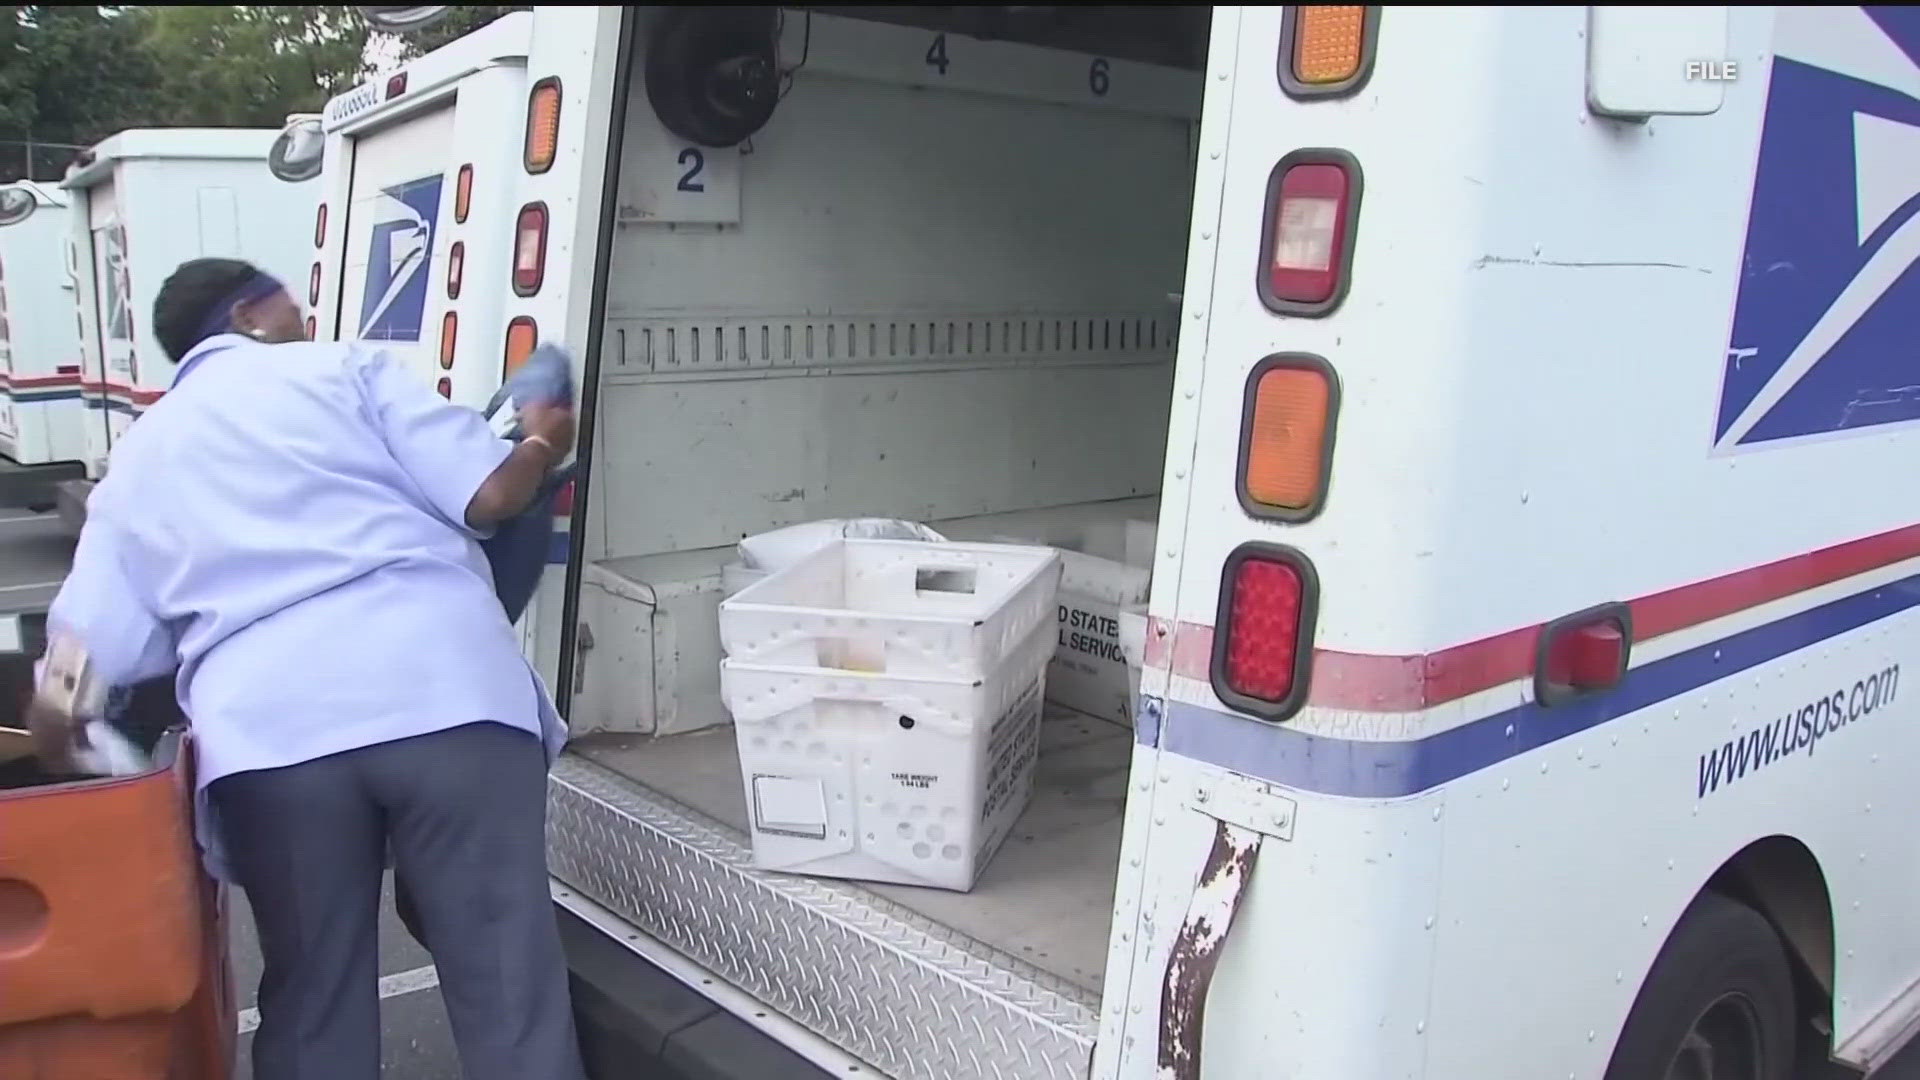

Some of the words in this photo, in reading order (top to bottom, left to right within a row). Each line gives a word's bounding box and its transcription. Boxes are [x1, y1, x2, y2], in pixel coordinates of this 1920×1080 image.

[926, 34, 949, 76] 4
[1089, 58, 1110, 97] 6
[676, 148, 705, 194] 2
[1070, 609, 1119, 638] STATE
[1070, 632, 1127, 665] SERVIC
[1698, 663, 1899, 799] www.usps.com
